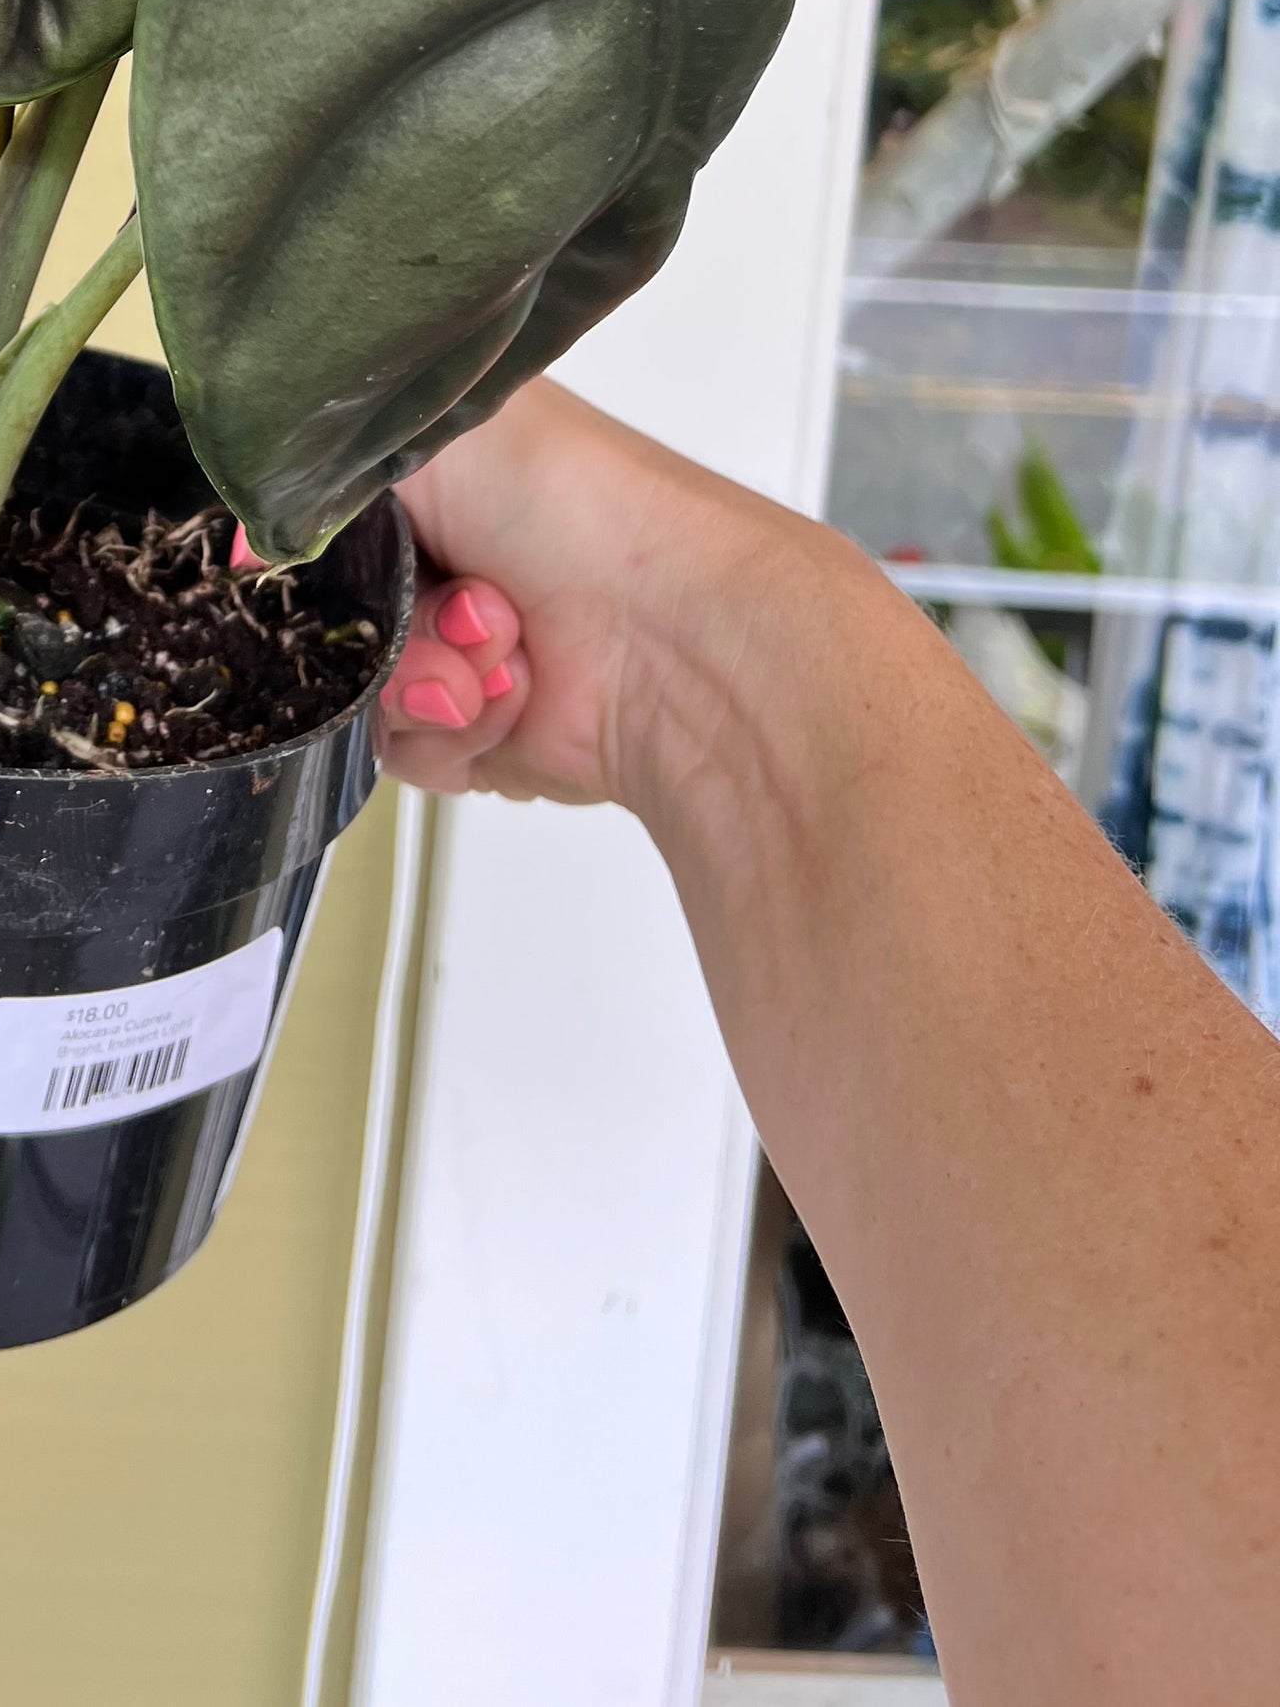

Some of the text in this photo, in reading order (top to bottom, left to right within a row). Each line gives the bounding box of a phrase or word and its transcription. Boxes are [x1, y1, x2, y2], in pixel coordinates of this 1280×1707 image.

[67, 1001, 128, 1023] $18.00
[60, 1011, 172, 1041] Alocasia Cuprea
[107, 1029, 159, 1051] Indirect
